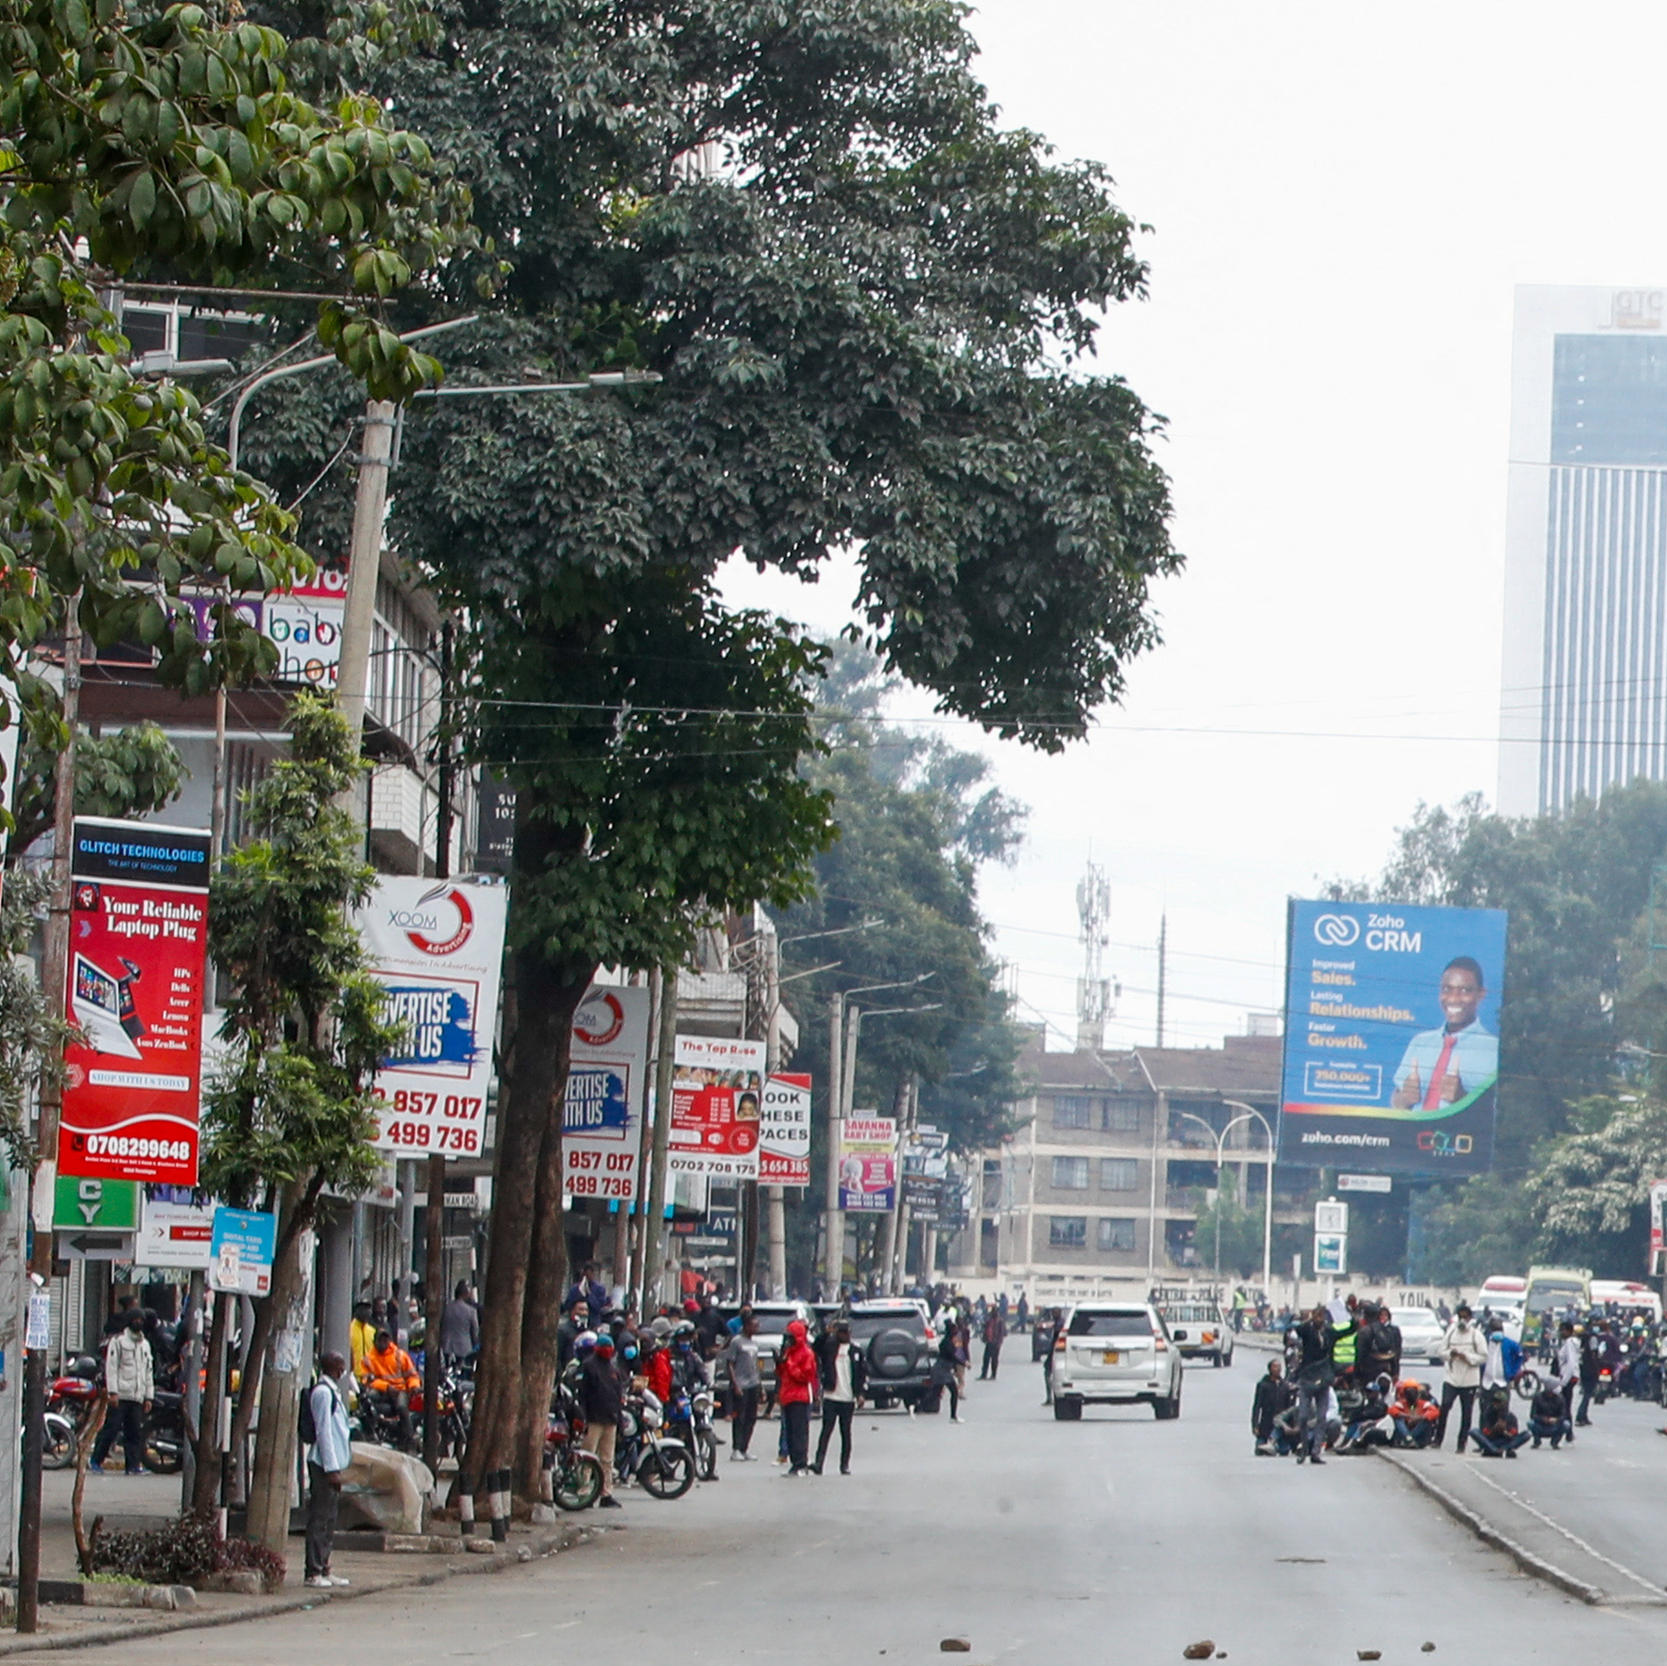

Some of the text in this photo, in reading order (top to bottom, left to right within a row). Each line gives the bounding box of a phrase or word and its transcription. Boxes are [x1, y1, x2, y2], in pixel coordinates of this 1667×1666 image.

[79, 839, 205, 863] GLITCH TECHNOLOGIES
[103, 896, 202, 921] Your Reliable
[107, 915, 197, 942] Laptop Plug
[387, 910, 438, 930] XOOM
[1367, 913, 1405, 929] Zoho
[1365, 930, 1422, 953] CRM
[374, 991, 452, 1024] DVERTISE
[1309, 1002, 1415, 1022] Relationships.
[419, 1025, 443, 1058] US
[1307, 1033, 1368, 1050] Growth.
[563, 1072, 609, 1100] ERTISE
[393, 1089, 439, 1115] 857
[444, 1095, 482, 1120] 017
[765, 1092, 801, 1104] OOK
[564, 1100, 604, 1127] ITH US
[761, 1109, 805, 1122] HESE
[387, 1121, 432, 1146] 499
[437, 1126, 478, 1152] 736
[760, 1128, 808, 1141] PACES
[1301, 1131, 1391, 1148] zoho.com/crm
[87, 1135, 190, 1160] 0708299648
[569, 1151, 635, 1172] 857 017
[670, 1159, 705, 1172] 0702
[565, 1175, 632, 1197] 499 736
[1399, 1291, 1424, 1307] YOU
